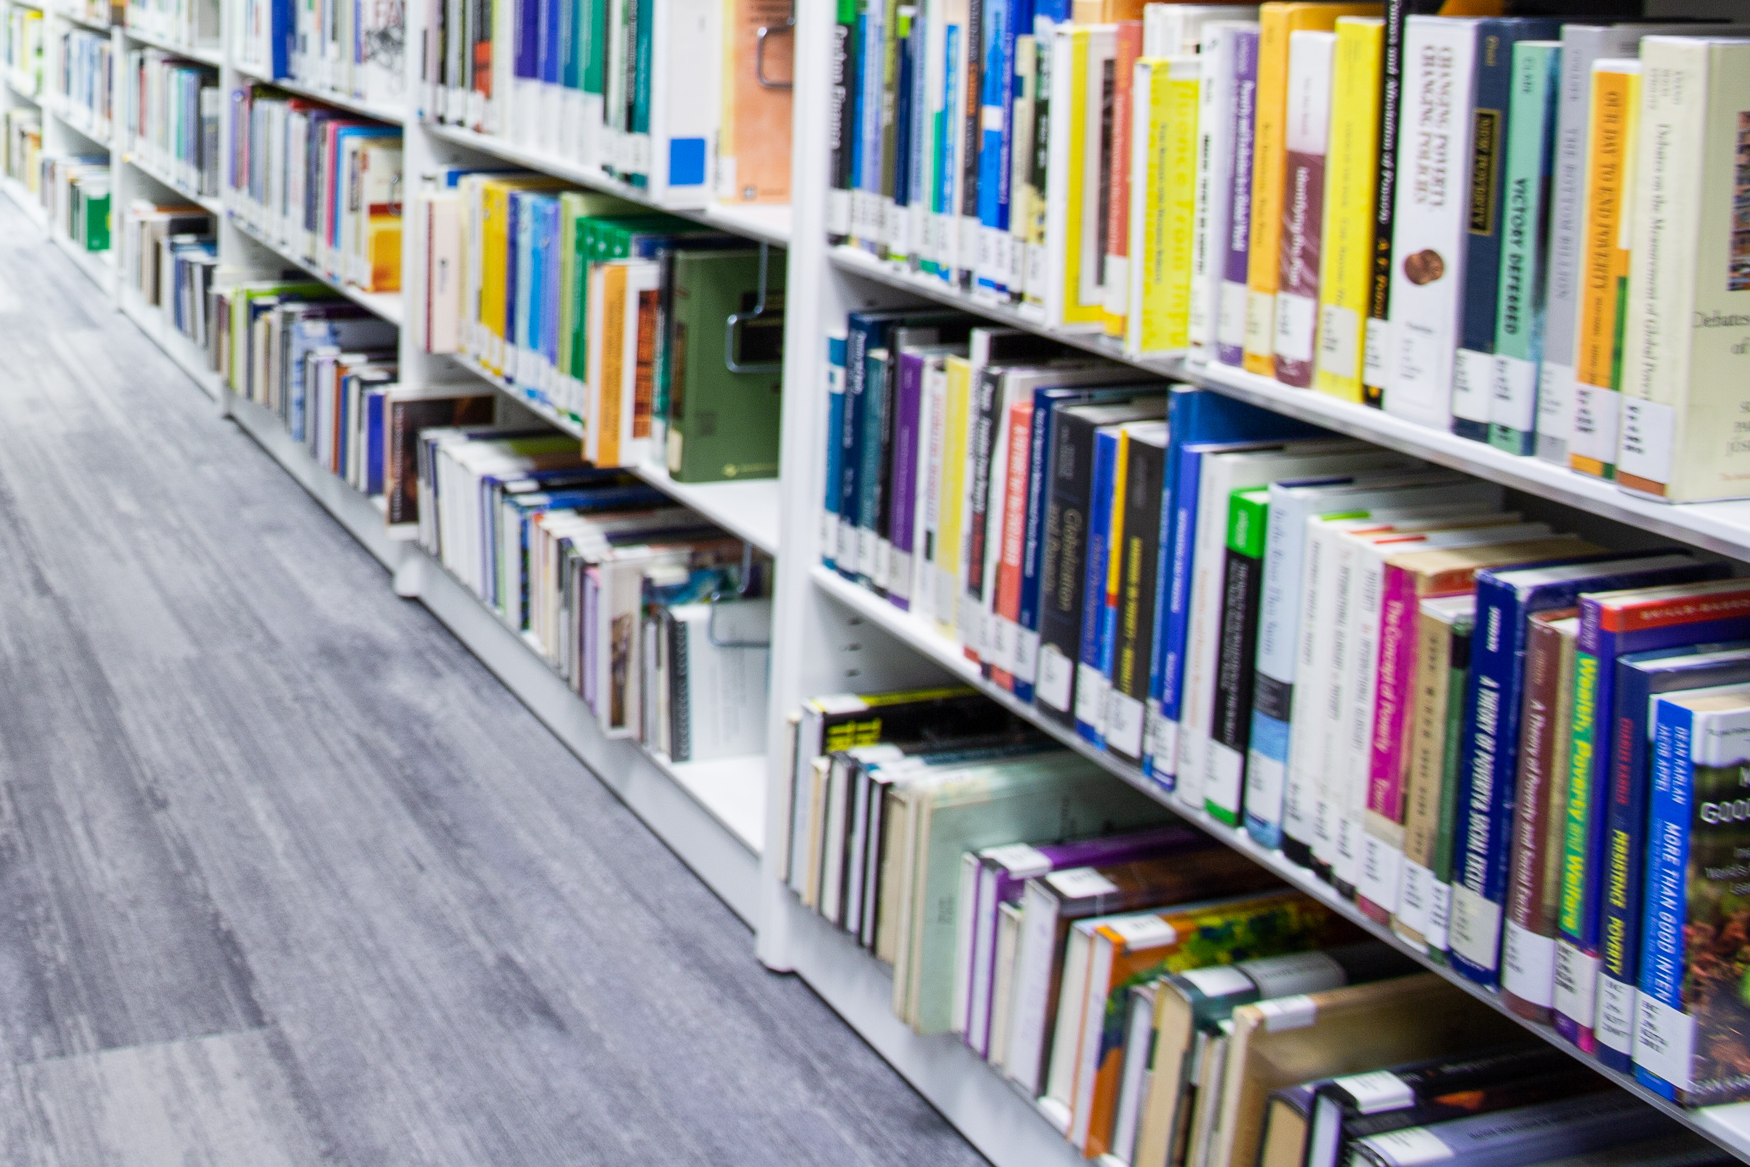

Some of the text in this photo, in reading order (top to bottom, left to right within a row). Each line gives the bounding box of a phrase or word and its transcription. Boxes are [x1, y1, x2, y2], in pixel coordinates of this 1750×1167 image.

[1567, 739, 1593, 822] Poverty
[1661, 821, 1683, 867] MORE
[1561, 853, 1586, 930] Welfare
[1659, 868, 1680, 911] THAN
[1605, 915, 1626, 976] POVERTY
[1656, 911, 1678, 955] GOOD
